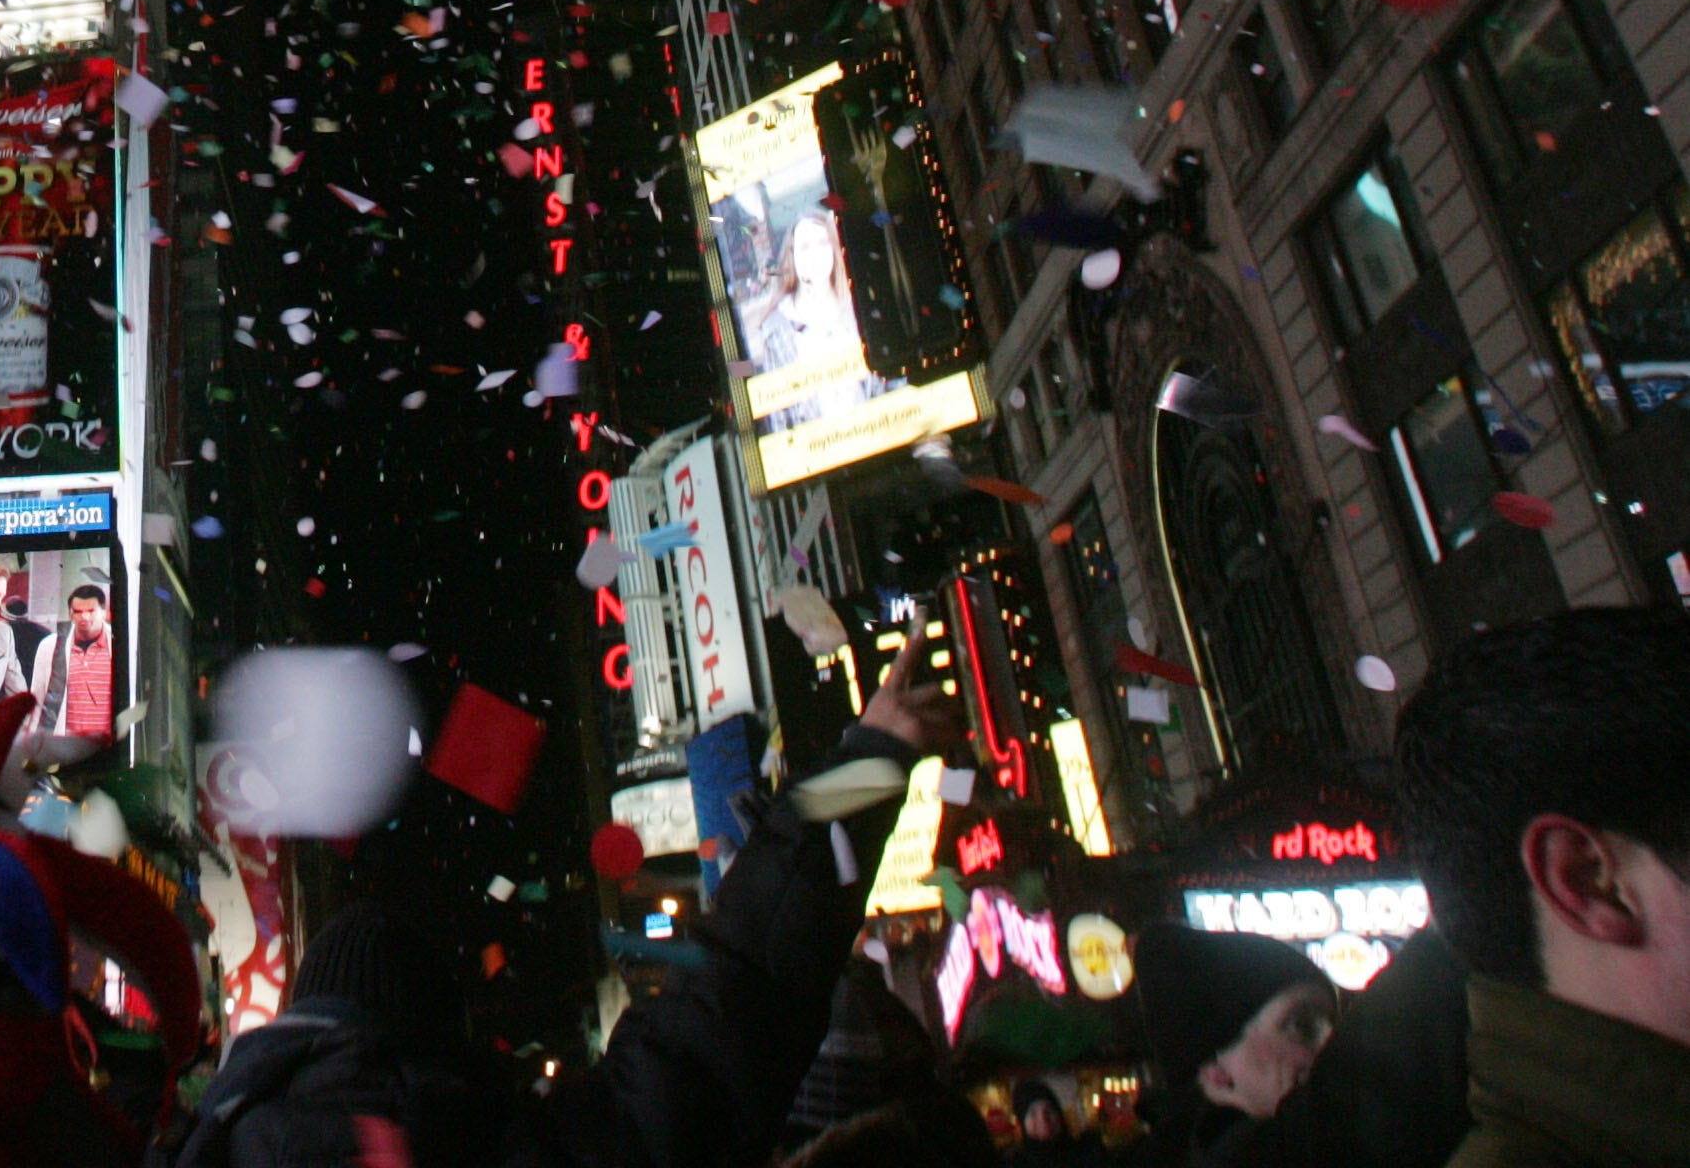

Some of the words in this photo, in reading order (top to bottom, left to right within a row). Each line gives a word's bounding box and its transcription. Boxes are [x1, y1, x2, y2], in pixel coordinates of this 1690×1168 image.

[523, 58, 575, 275] ERNST
[570, 410, 634, 690] YONG
[673, 465, 726, 713] RICOH
[1308, 821, 1379, 866] Rock
[1334, 882, 1431, 936] ROC
